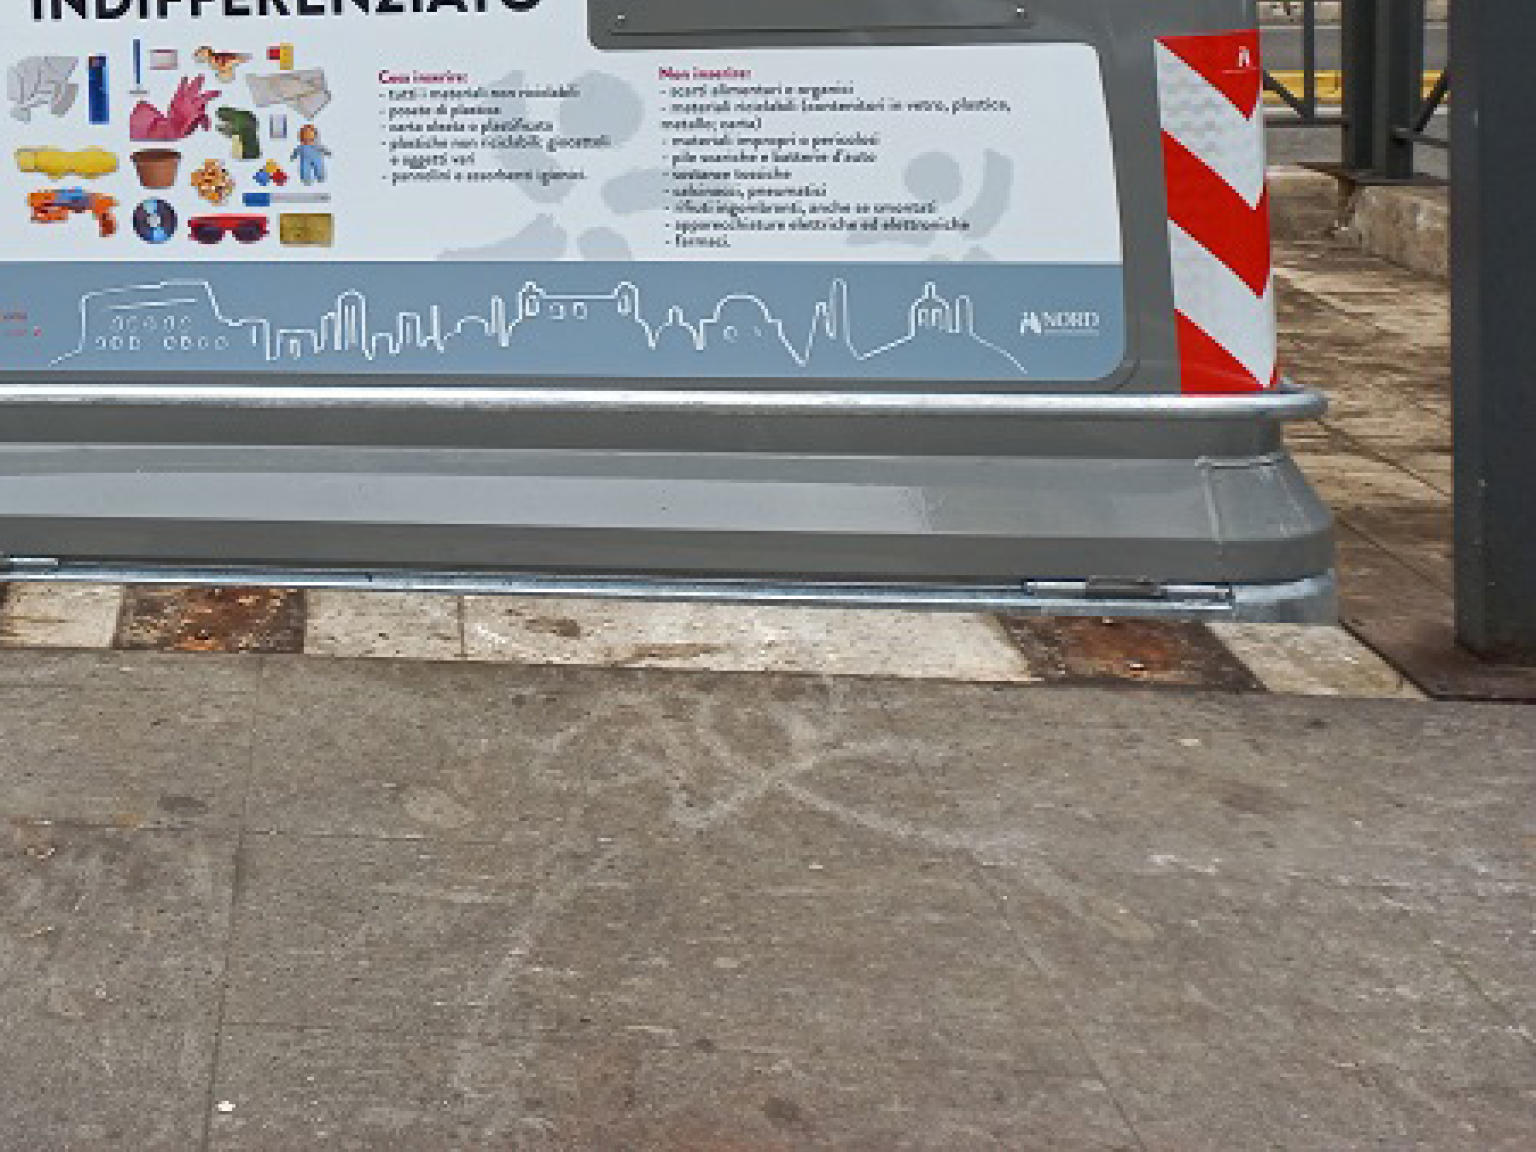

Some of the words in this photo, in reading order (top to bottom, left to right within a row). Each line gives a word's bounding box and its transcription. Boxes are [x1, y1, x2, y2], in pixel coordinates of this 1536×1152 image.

[378, 69, 410, 84] Cosa
[658, 66, 690, 80] Non
[1043, 311, 1100, 327] NORD
